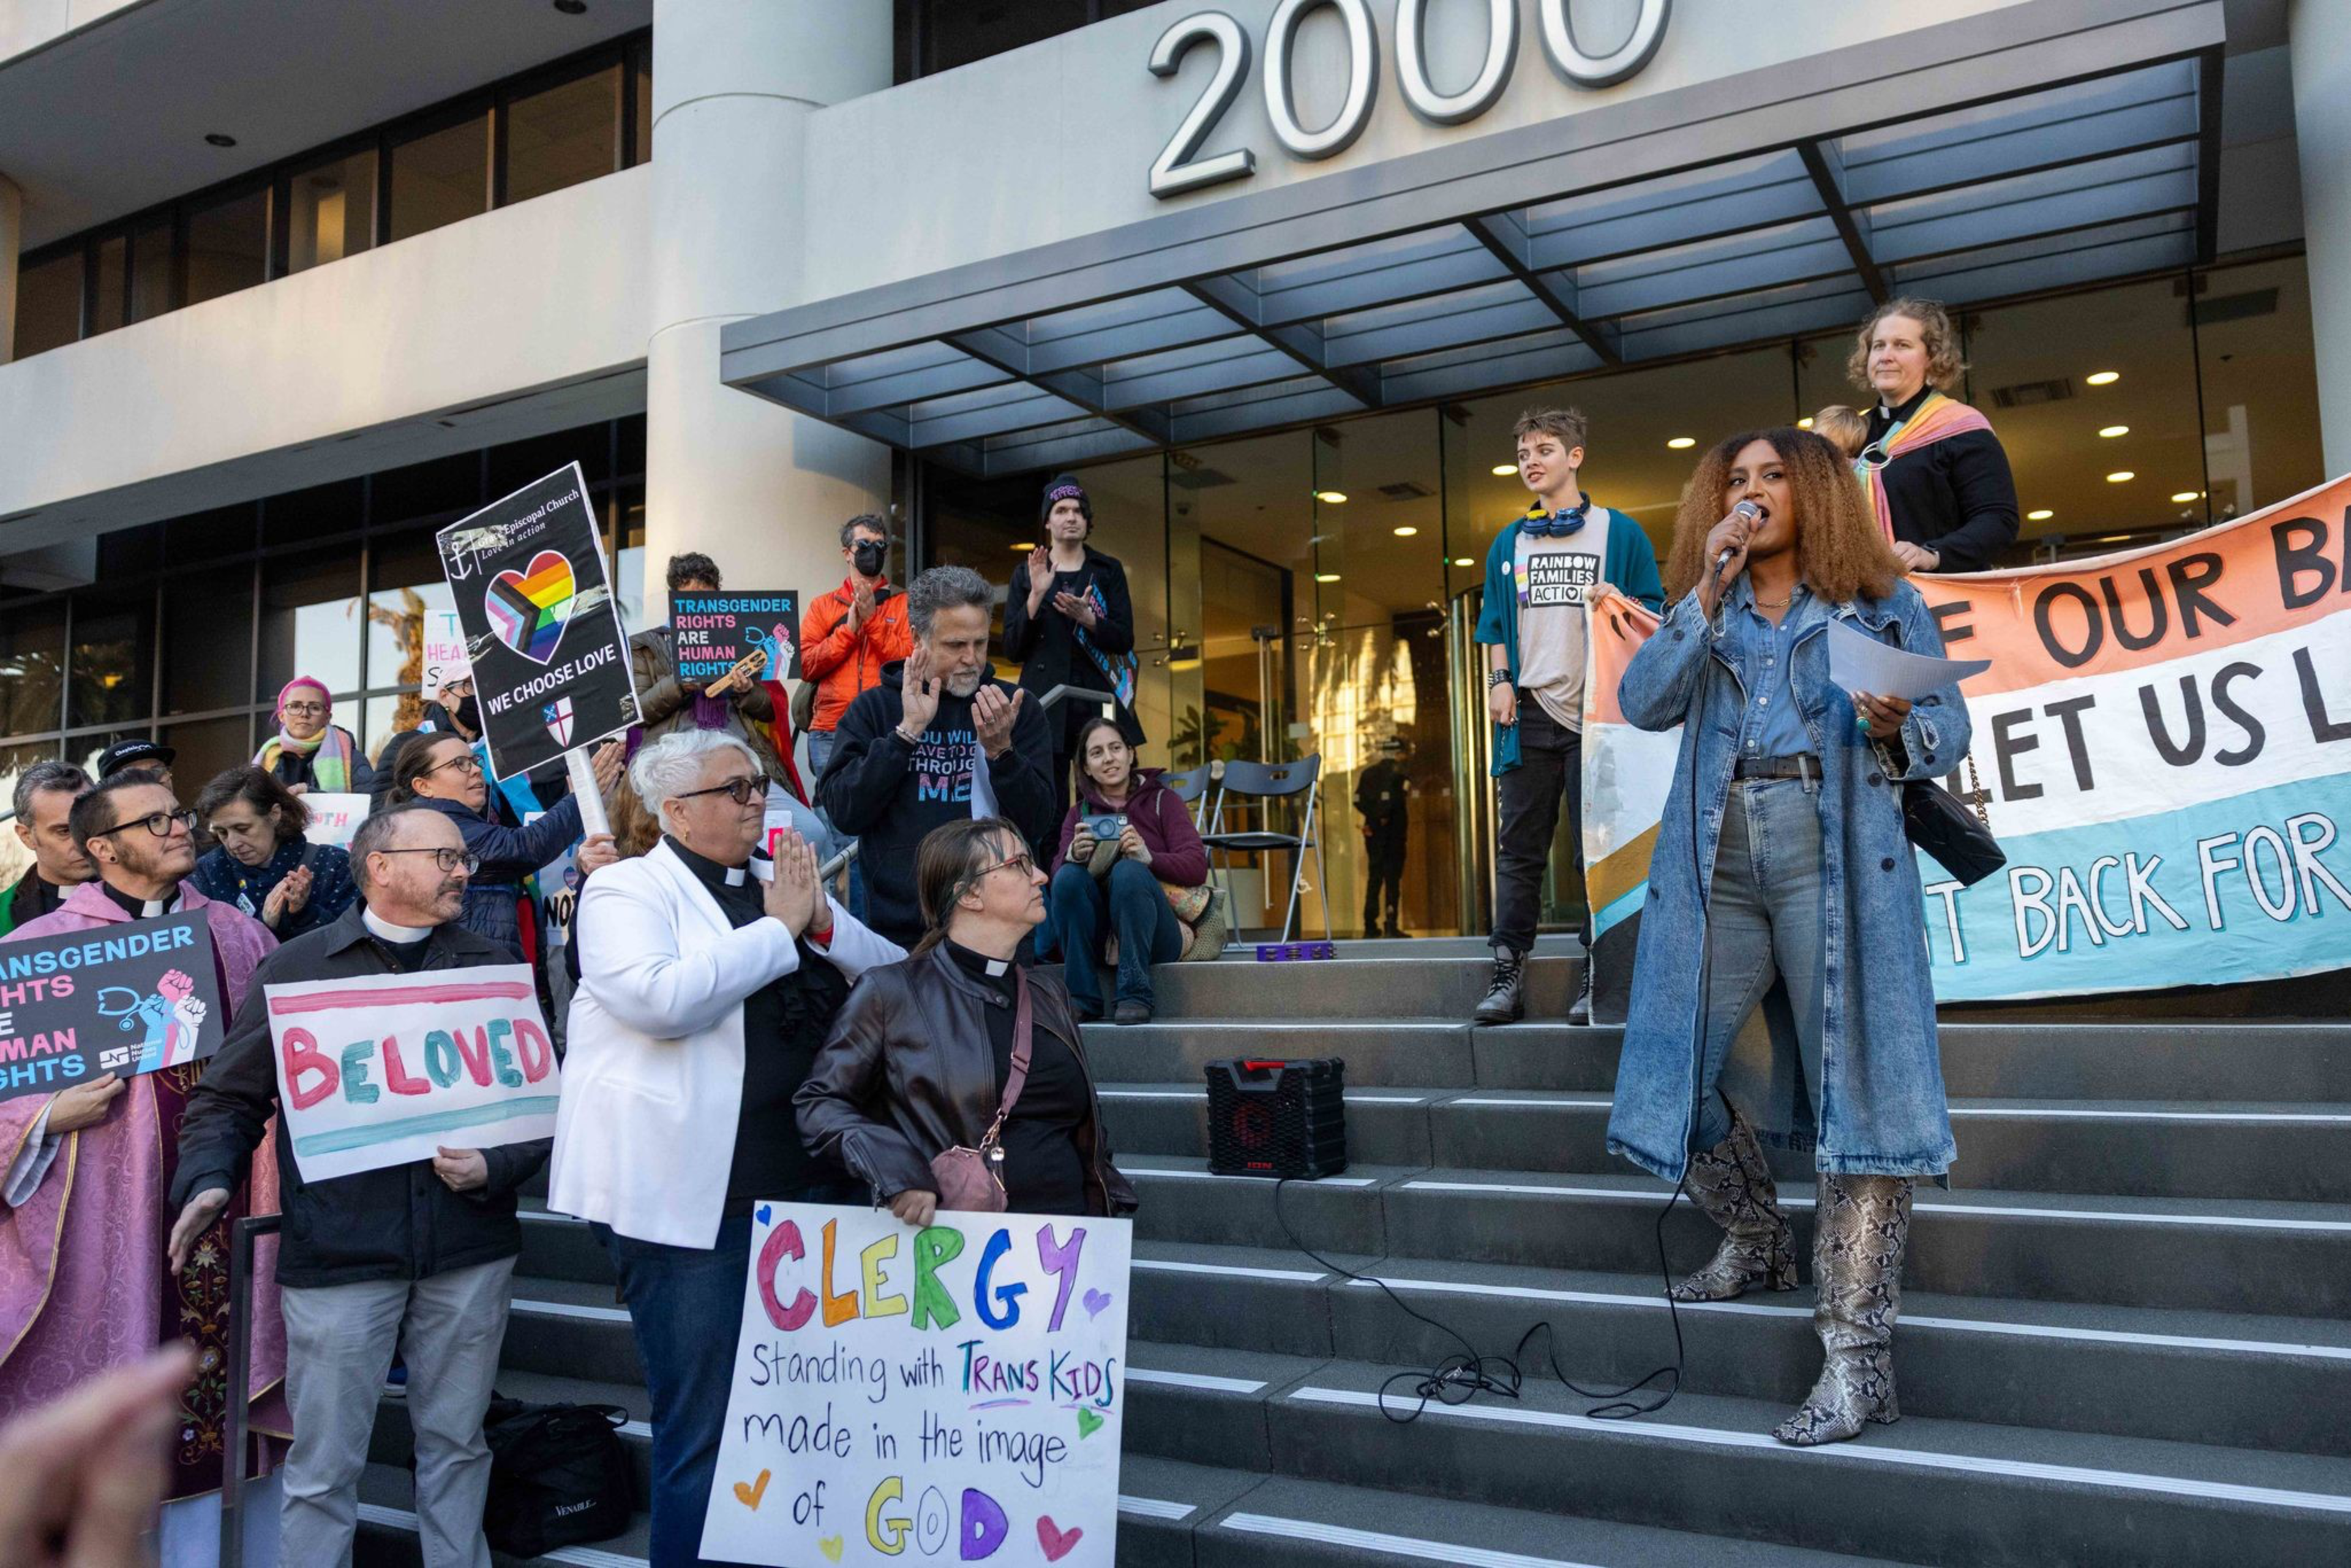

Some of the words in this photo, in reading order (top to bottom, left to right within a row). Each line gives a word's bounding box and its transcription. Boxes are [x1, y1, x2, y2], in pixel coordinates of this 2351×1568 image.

[503, 505, 546, 535] Episcopal
[546, 489, 579, 512] Church
[481, 545, 502, 560] Love
[505, 538, 515, 547] in
[517, 522, 546, 542] action
[1530, 569, 1595, 584] FAMILIES
[1531, 555, 1597, 570] RAINBOW
[2034, 552, 2237, 669] OUR
[2271, 505, 2351, 610] B
[674, 598, 792, 613] TRANSGENDER
[676, 615, 737, 629] RIGHTS
[677, 631, 710, 645] ARE
[678, 646, 735, 660] HUMAN
[487, 694, 511, 716] WE
[513, 664, 574, 703] CHOOSE
[577, 643, 617, 676] LOVE
[2138, 661, 2267, 768] US
[912, 745, 945, 759] AVE
[916, 730, 942, 745] OU
[948, 729, 978, 745] WIL
[908, 757, 975, 775] THROUG
[918, 772, 973, 802] ME
[2008, 852, 2191, 958] BACK
[2198, 812, 2351, 931] FOR
[0, 975, 75, 1008] HTS
[282, 1018, 552, 1111] BELOVED
[756, 1217, 1087, 1334] CLERGY
[749, 1340, 888, 1404] Standing
[900, 1347, 945, 1389] with
[956, 1339, 1040, 1395] TRANS
[1049, 1348, 1117, 1408] KIDS
[743, 1401, 852, 1460] made
[872, 1422, 898, 1460] in
[918, 1408, 964, 1463] the
[976, 1419, 1068, 1488] image
[793, 1479, 827, 1528] of
[864, 1475, 1009, 1562] GOD
